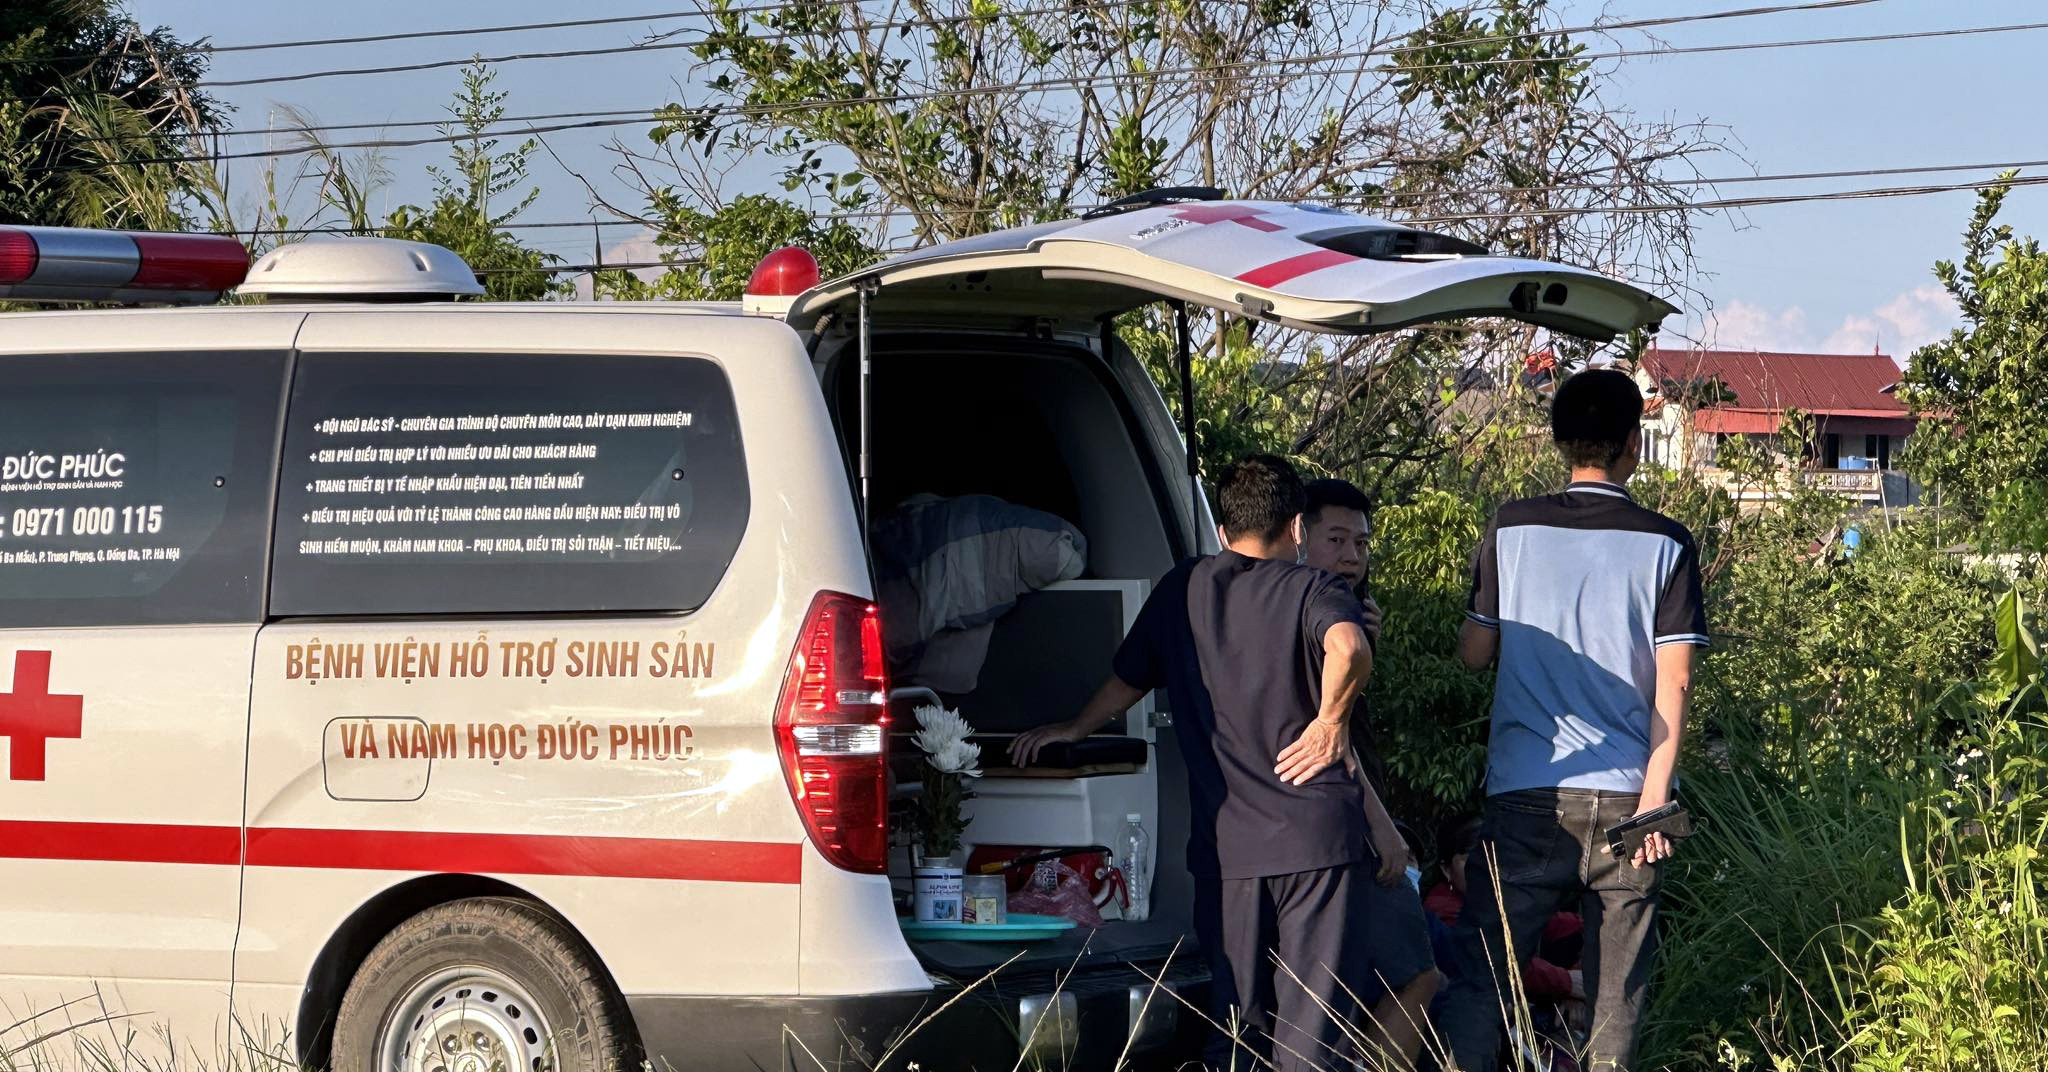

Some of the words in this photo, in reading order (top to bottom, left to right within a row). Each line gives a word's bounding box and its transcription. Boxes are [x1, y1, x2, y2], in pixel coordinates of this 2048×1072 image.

[322, 418, 339, 435] ĐỘI
[339, 418, 361, 432] NGŨ
[361, 417, 380, 432] BÁC
[380, 417, 394, 431] SỸ
[401, 416, 438, 431] CHUYÊN
[438, 418, 455, 430] GIA
[456, 415, 484, 430] TRÌNH
[484, 415, 498, 431] ĐỘ
[499, 414, 537, 429] CHUYÊN
[538, 414, 562, 428] MÔN
[562, 415, 584, 429] CAO,
[585, 413, 604, 427] DÀY
[605, 415, 627, 429] DẠN
[628, 414, 652, 426] KINH
[652, 411, 692, 428] NGHIỆM
[2, 451, 56, 479] ĐỨC
[59, 449, 126, 478] PHÚC
[318, 450, 335, 462] CHI
[336, 447, 354, 462] PHÍ
[354, 446, 377, 461] ĐIỀU
[378, 449, 394, 463] TRỊ
[395, 448, 415, 463] HỢP
[416, 446, 429, 460] LÝ
[429, 446, 446, 460] VỚI
[447, 444, 477, 460] NHIỀU
[478, 446, 492, 459] ƯU
[493, 445, 510, 459] ĐÃI
[512, 446, 532, 459] CHO
[534, 444, 567, 458] KHÁCH
[568, 443, 597, 458] HÀNG
[315, 480, 346, 492] TRANG
[347, 476, 374, 492] THIẾT
[374, 479, 385, 494] BỊ
[386, 479, 394, 491] Y
[395, 475, 408, 491] TẾ
[407, 476, 434, 493] NHẬP
[436, 473, 463, 490] KHẨU
[463, 475, 487, 493] HIỆN
[488, 477, 508, 492] ĐẠI,
[510, 475, 532, 489] TIÊN
[534, 473, 556, 489] TIẾN
[557, 472, 584, 489] NHẤT
[12, 508, 65, 536] 0971
[72, 507, 115, 535] 000
[122, 506, 163, 533] 115
[311, 507, 334, 523] ĐIỀU
[335, 510, 351, 525] TRỊ
[351, 508, 374, 525] HIỆU
[375, 506, 395, 523] QUẢ
[396, 507, 413, 521] VỚI
[414, 505, 426, 521] TỶ
[427, 507, 439, 523] LỆ
[441, 507, 472, 521] THÀNH
[474, 506, 502, 520] CÔNG
[503, 508, 523, 520] CAO
[524, 505, 552, 520] HÀNG
[552, 503, 574, 519] ĐẦU
[575, 505, 599, 522] HIỆN
[600, 507, 622, 519] NAY:
[623, 503, 648, 519] ĐIỀU
[649, 506, 665, 521] TRỊ
[666, 503, 680, 518] VÔ
[299, 541, 323, 553] SINH
[324, 537, 348, 553] HIẾM
[350, 538, 381, 555] MUỘN,
[383, 537, 412, 552] KHÁM
[413, 540, 437, 552] NAM
[437, 540, 464, 552] KHOA
[473, 539, 494, 554] PHỤ
[495, 539, 524, 552] KHOA,
[525, 535, 549, 551] ĐIỀU
[550, 538, 567, 553] TRỊ
[568, 534, 587, 550] SỎI
[587, 536, 614, 553] THẬN
[624, 534, 645, 550] TIẾT
[285, 636, 365, 686] BỆNH
[373, 636, 441, 685] VIỆN
[448, 629, 490, 679] HỖ
[500, 637, 558, 685] TRỢ
[565, 641, 640, 678] SINH
[649, 631, 715, 679] SẢN
[340, 718, 379, 760] VÀ
[387, 723, 457, 761] NAM
[467, 723, 528, 766] HỌC
[537, 716, 599, 761] ĐỨC
[609, 717, 694, 761] PHÚC
